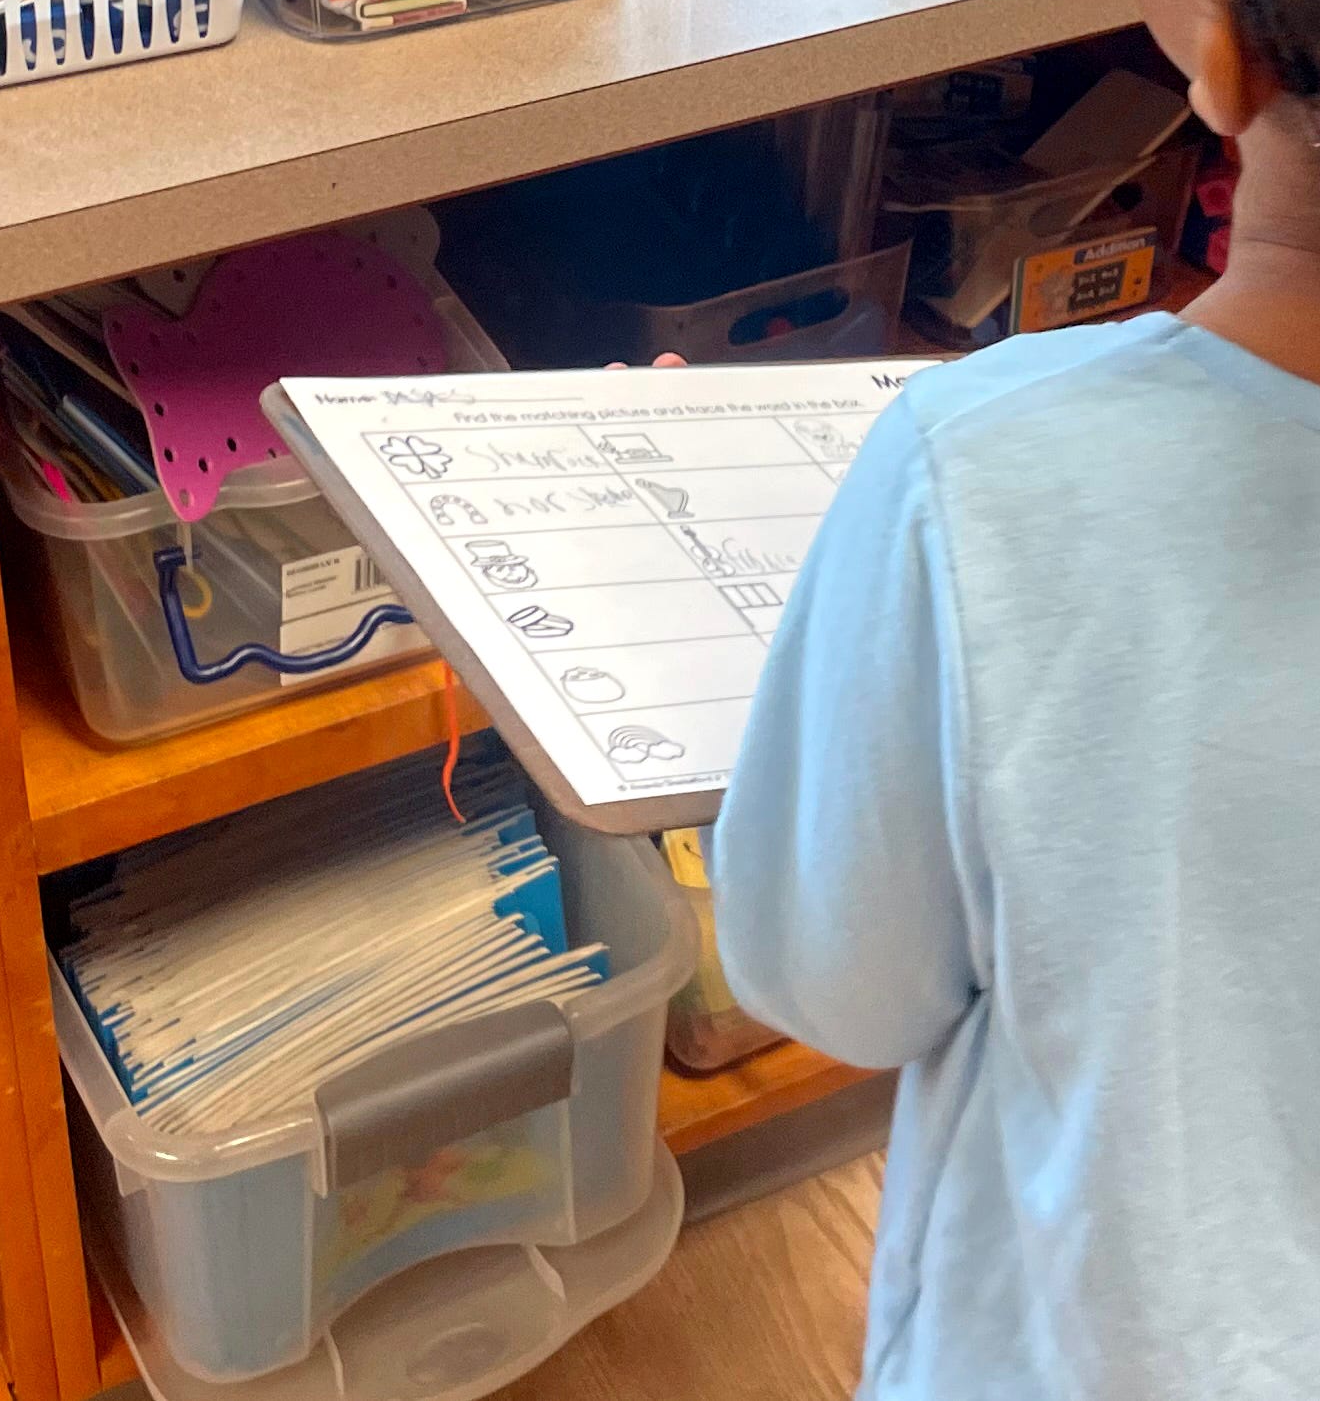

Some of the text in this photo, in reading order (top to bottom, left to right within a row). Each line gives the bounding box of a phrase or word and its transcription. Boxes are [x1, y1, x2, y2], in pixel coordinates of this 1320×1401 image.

[1083, 237, 1147, 263] Addition
[453, 411, 488, 424] Find
[489, 411, 518, 423] the
[520, 408, 597, 422] matching
[597, 405, 651, 420] picture
[653, 403, 684, 416] and
[687, 402, 726, 415] trace
[727, 401, 753, 413] the
[755, 400, 791, 412] word
[807, 399, 832, 410] the
